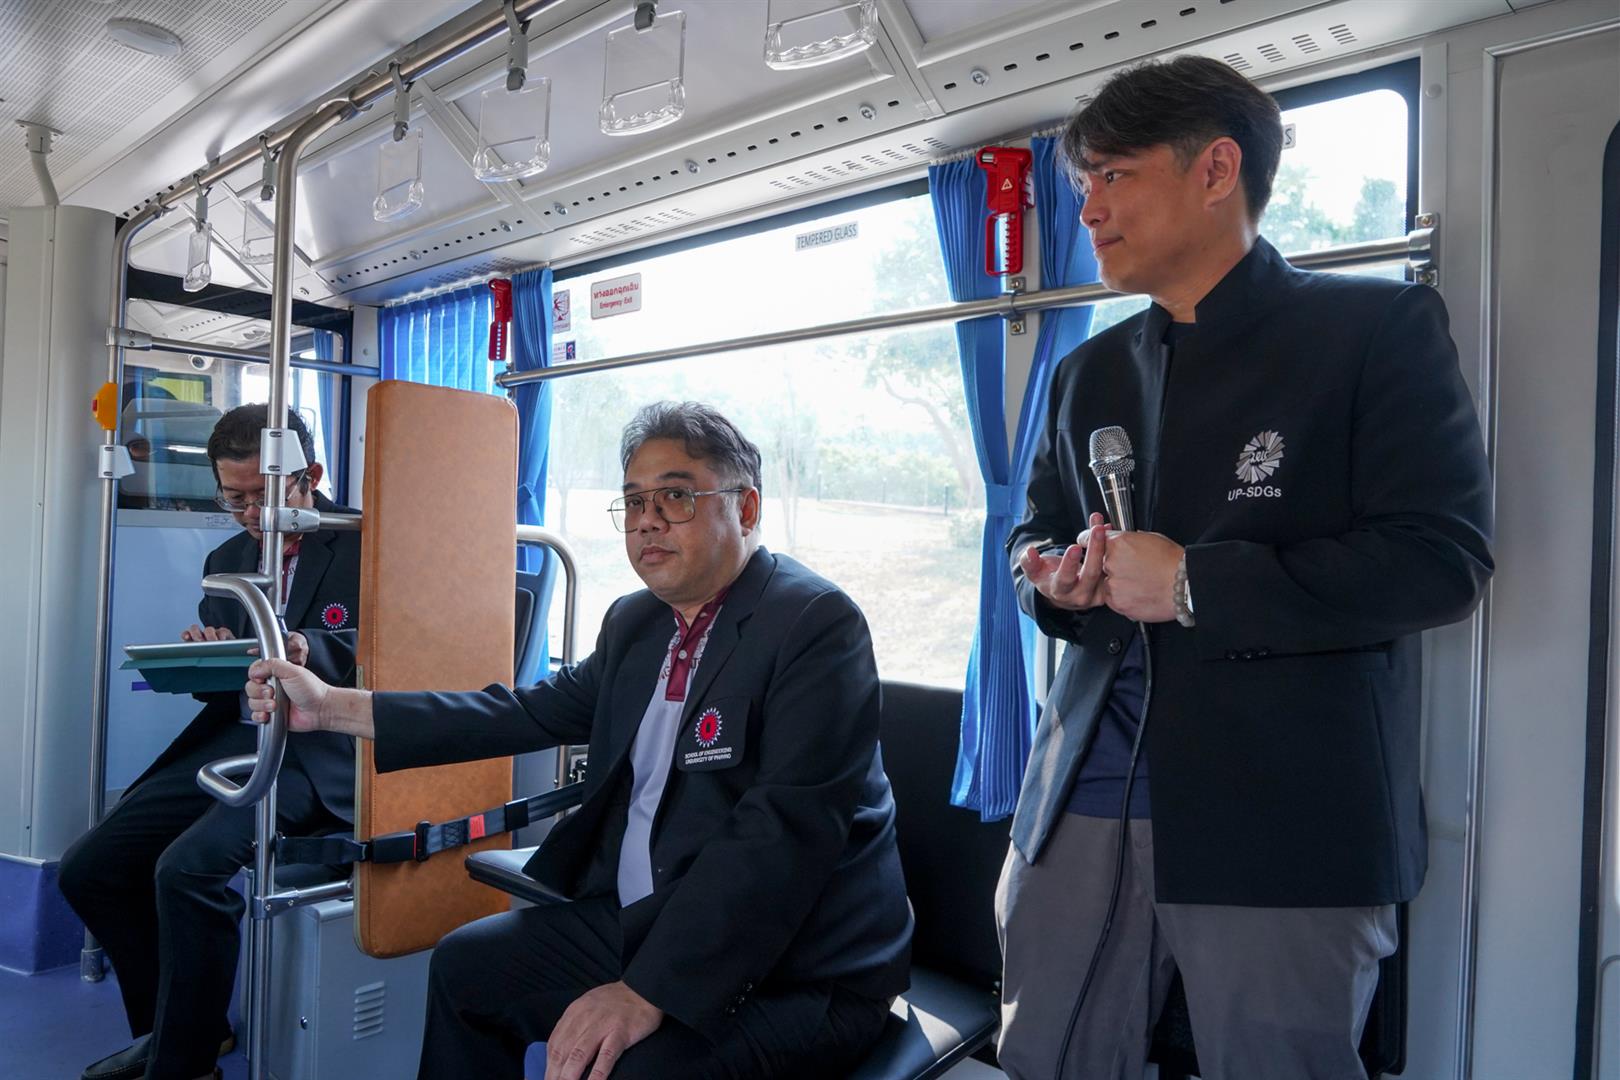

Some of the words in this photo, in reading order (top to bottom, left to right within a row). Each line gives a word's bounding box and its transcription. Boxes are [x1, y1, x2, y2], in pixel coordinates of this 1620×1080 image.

[797, 230, 833, 248] TEMPERED
[834, 223, 857, 241] GLASS
[599, 300, 622, 309] Emergency
[624, 296, 633, 304] Exit
[1228, 486, 1282, 501] UP-SDGs
[704, 747, 732, 755] ENGINEERING
